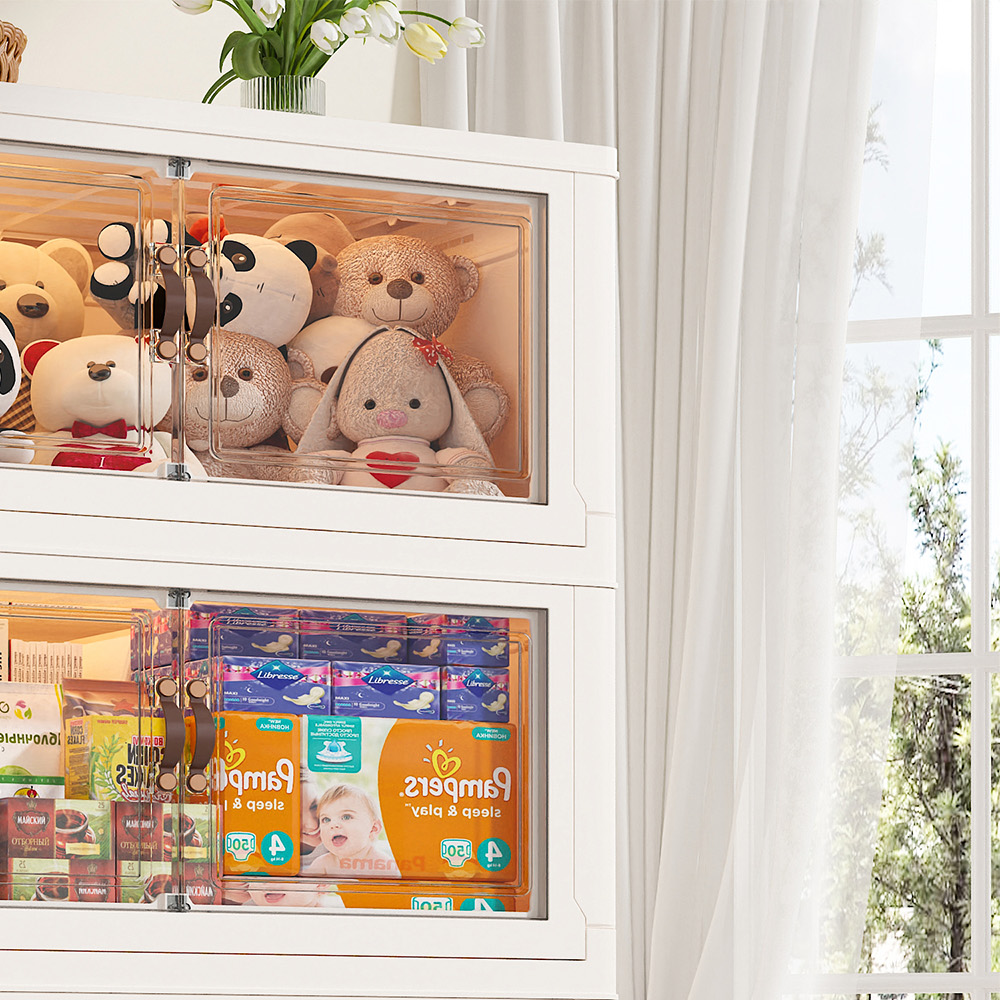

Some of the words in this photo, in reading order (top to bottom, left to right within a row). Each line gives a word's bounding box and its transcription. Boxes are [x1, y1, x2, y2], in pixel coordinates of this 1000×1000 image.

[257, 670, 298, 680] Libresse
[368, 676, 409, 685] Libresse
[466, 680, 492, 688] Libresse
[17, 815, 46, 825] МАЙСКИЙ
[11, 837, 50, 846] ОТБОРНЫЙ
